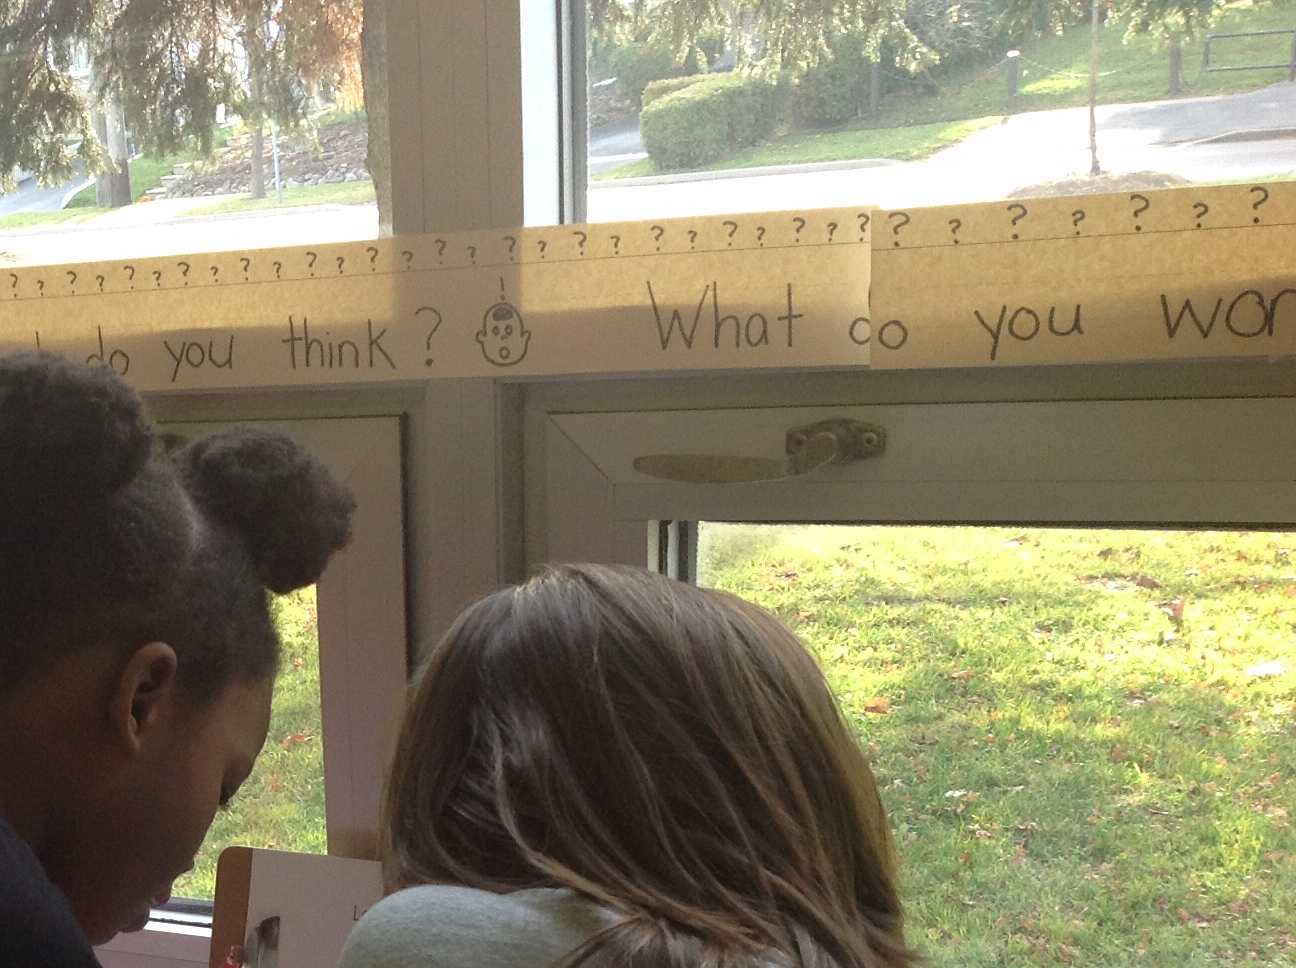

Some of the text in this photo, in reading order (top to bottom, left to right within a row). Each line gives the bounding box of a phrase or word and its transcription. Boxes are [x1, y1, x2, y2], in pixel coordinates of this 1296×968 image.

[645, 279, 804, 351] What
[973, 302, 1085, 361] you
[163, 334, 235, 383] you
